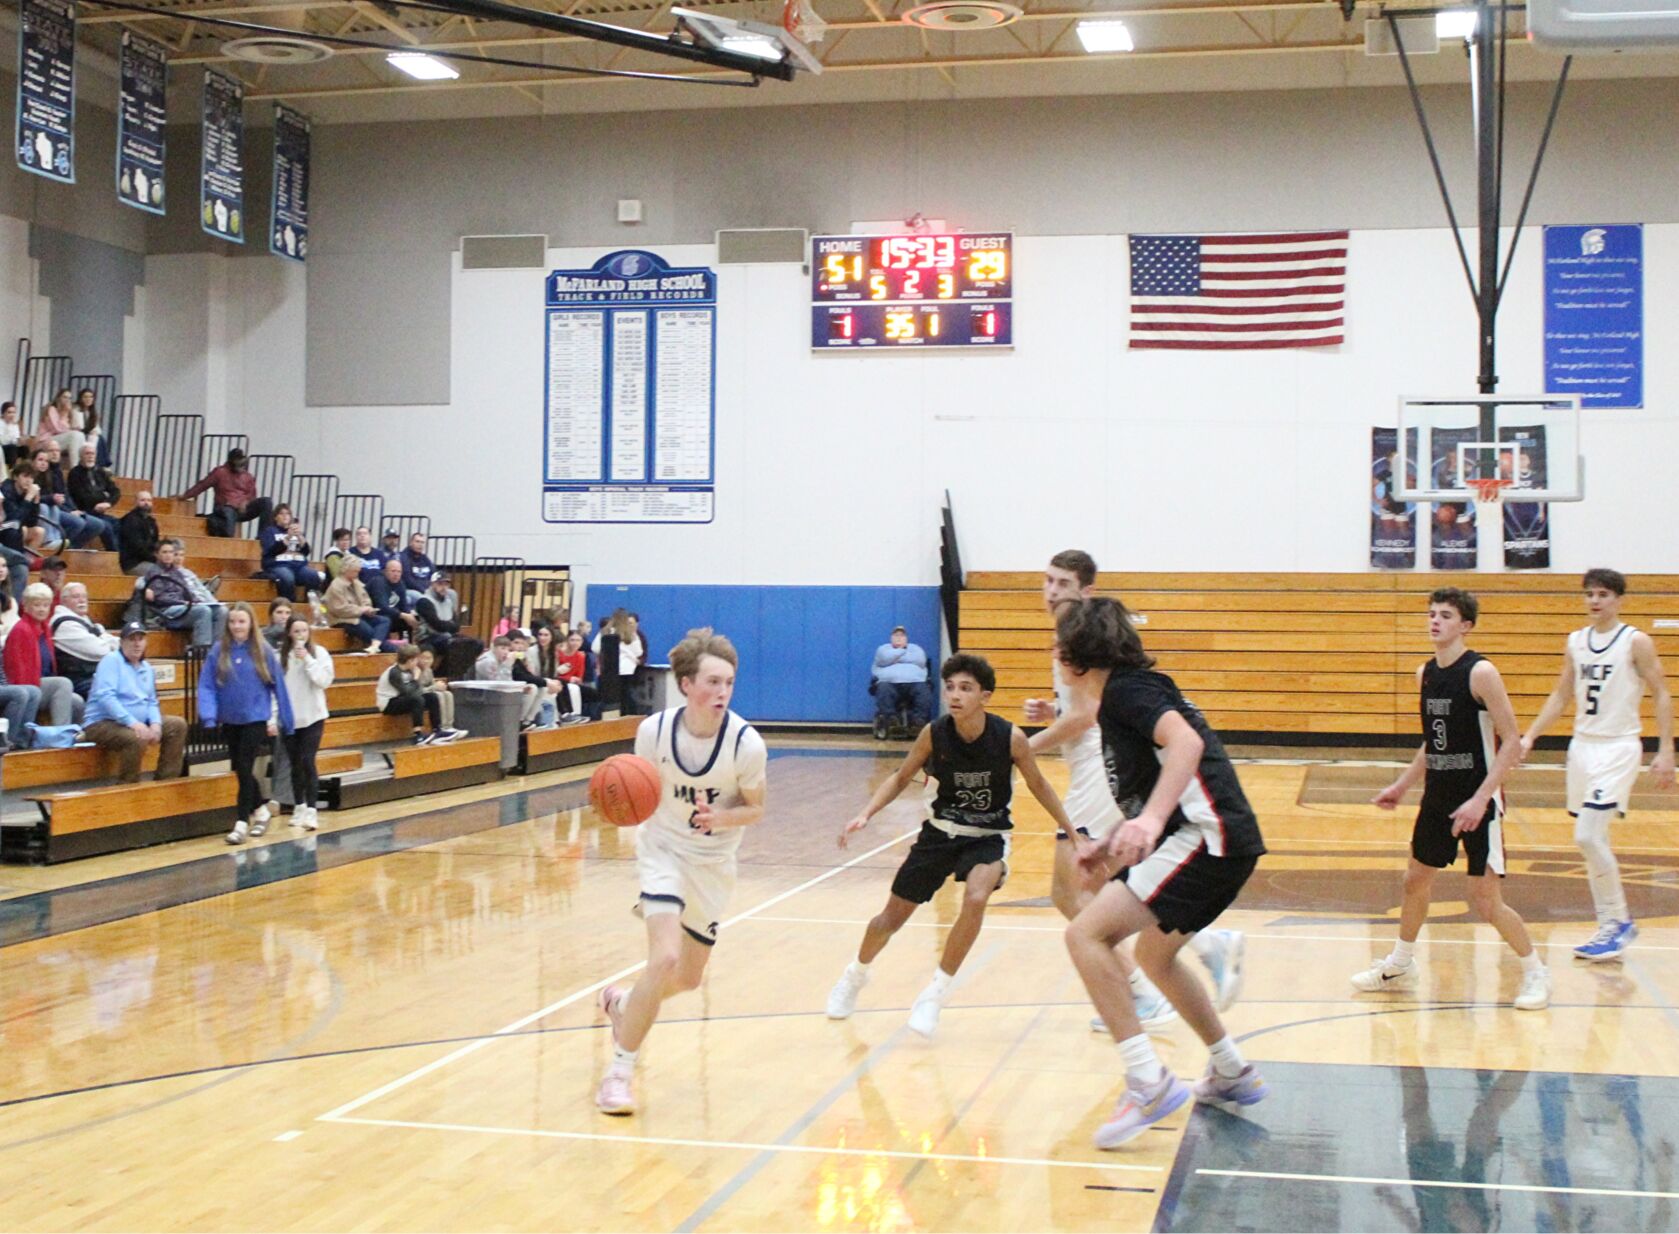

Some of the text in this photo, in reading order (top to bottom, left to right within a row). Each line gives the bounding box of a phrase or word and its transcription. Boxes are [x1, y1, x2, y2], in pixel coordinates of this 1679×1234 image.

[820, 241, 862, 253] HOME
[960, 237, 1007, 250] GUEST
[827, 254, 863, 283] 51
[968, 251, 1006, 280] 29
[628, 279, 658, 291] HIGH
[661, 273, 706, 290] SCHOOL
[870, 275, 887, 300] 5
[904, 270, 920, 294] 2
[938, 274, 953, 299] 3
[558, 293, 593, 301] TRACK
[610, 292, 644, 300] FIELD
[651, 290, 704, 299] RECORDS
[617, 317, 643, 325] EVENTS
[679, 311, 708, 319] RECORDS
[843, 315, 852, 337] 1
[885, 313, 915, 339] 35
[929, 314, 939, 336] 1
[986, 313, 995, 335] 1
[1426, 698, 1452, 715] FORT
[1585, 685, 1602, 715] 5
[1432, 719, 1448, 751] 3
[953, 771, 991, 788] FORT
[955, 789, 992, 811] 23
